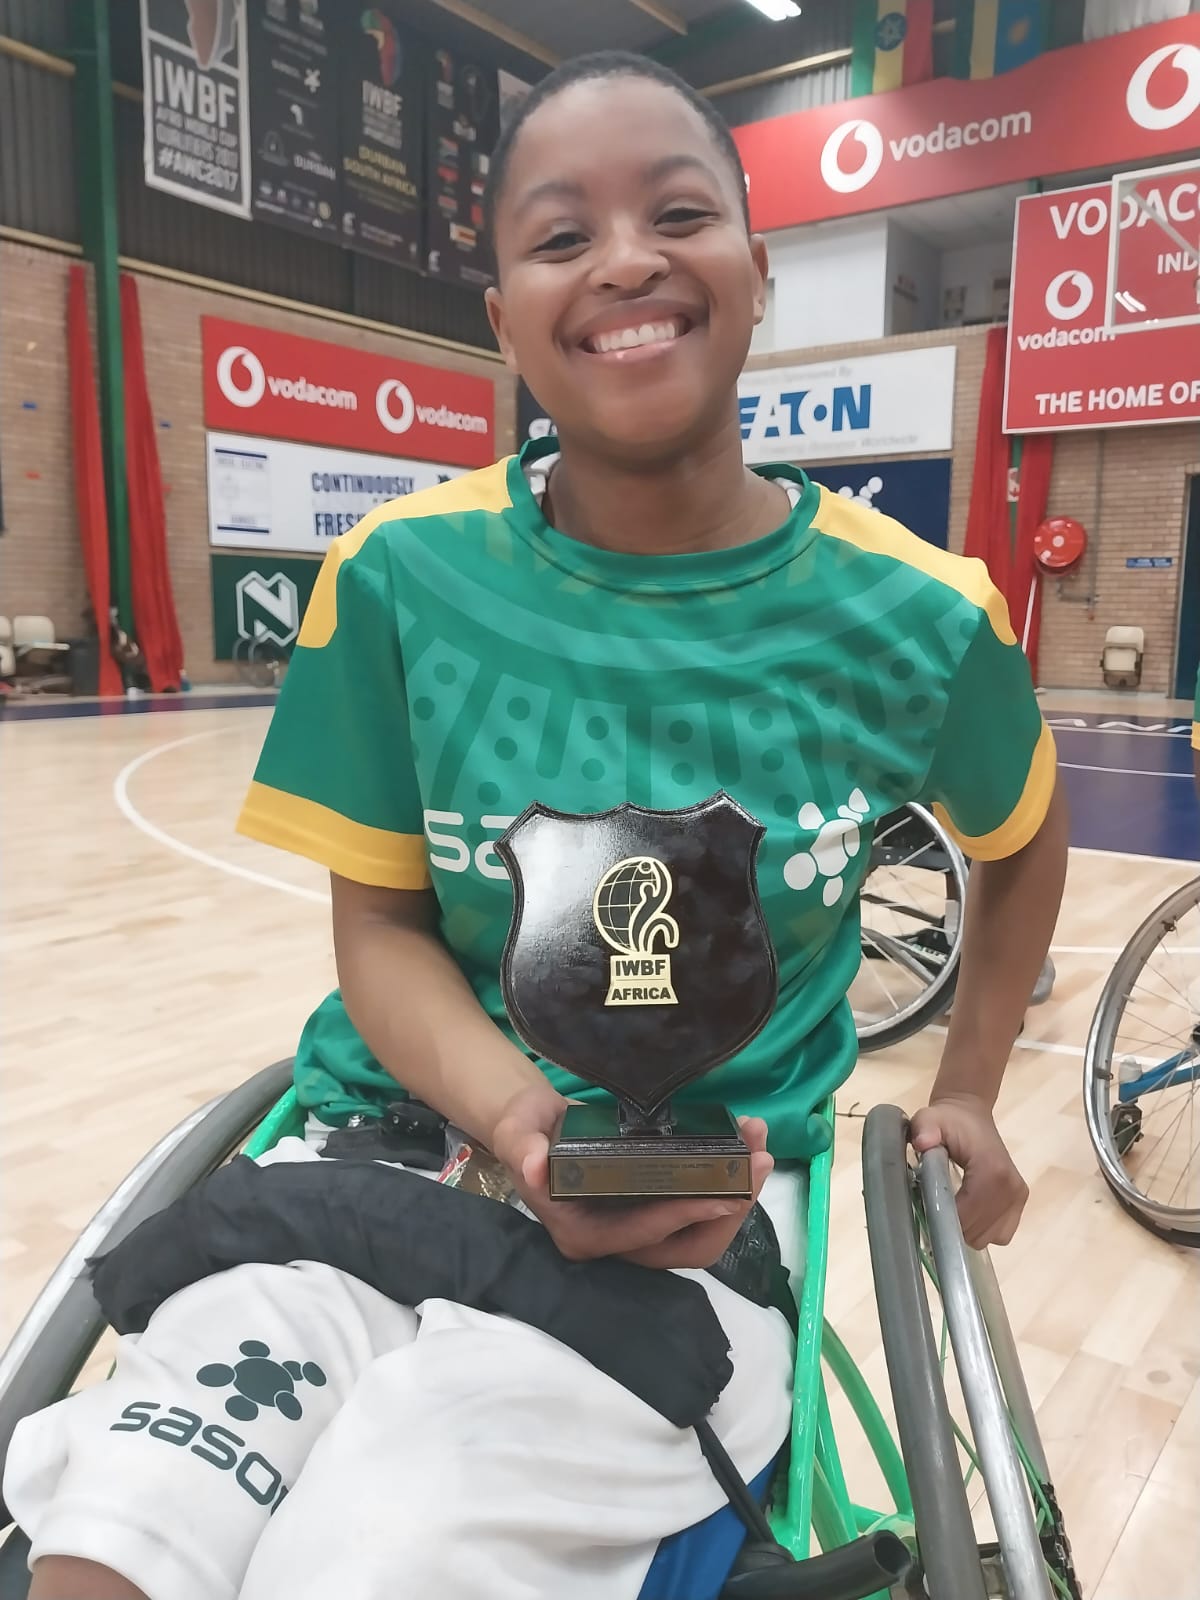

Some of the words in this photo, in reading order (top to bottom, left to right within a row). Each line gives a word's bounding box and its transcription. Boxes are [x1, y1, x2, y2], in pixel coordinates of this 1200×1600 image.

[153, 54, 236, 128] IWBF
[889, 110, 1032, 161] vodacom
[1050, 183, 1200, 239] VODAC
[267, 376, 357, 410] vodacom
[1035, 390, 1083, 415] THE
[1088, 384, 1164, 411] HOME
[415, 404, 487, 434] vodacom
[314, 512, 366, 536] FRES
[615, 959, 666, 976] IWBF
[611, 986, 671, 1000] AFRICA
